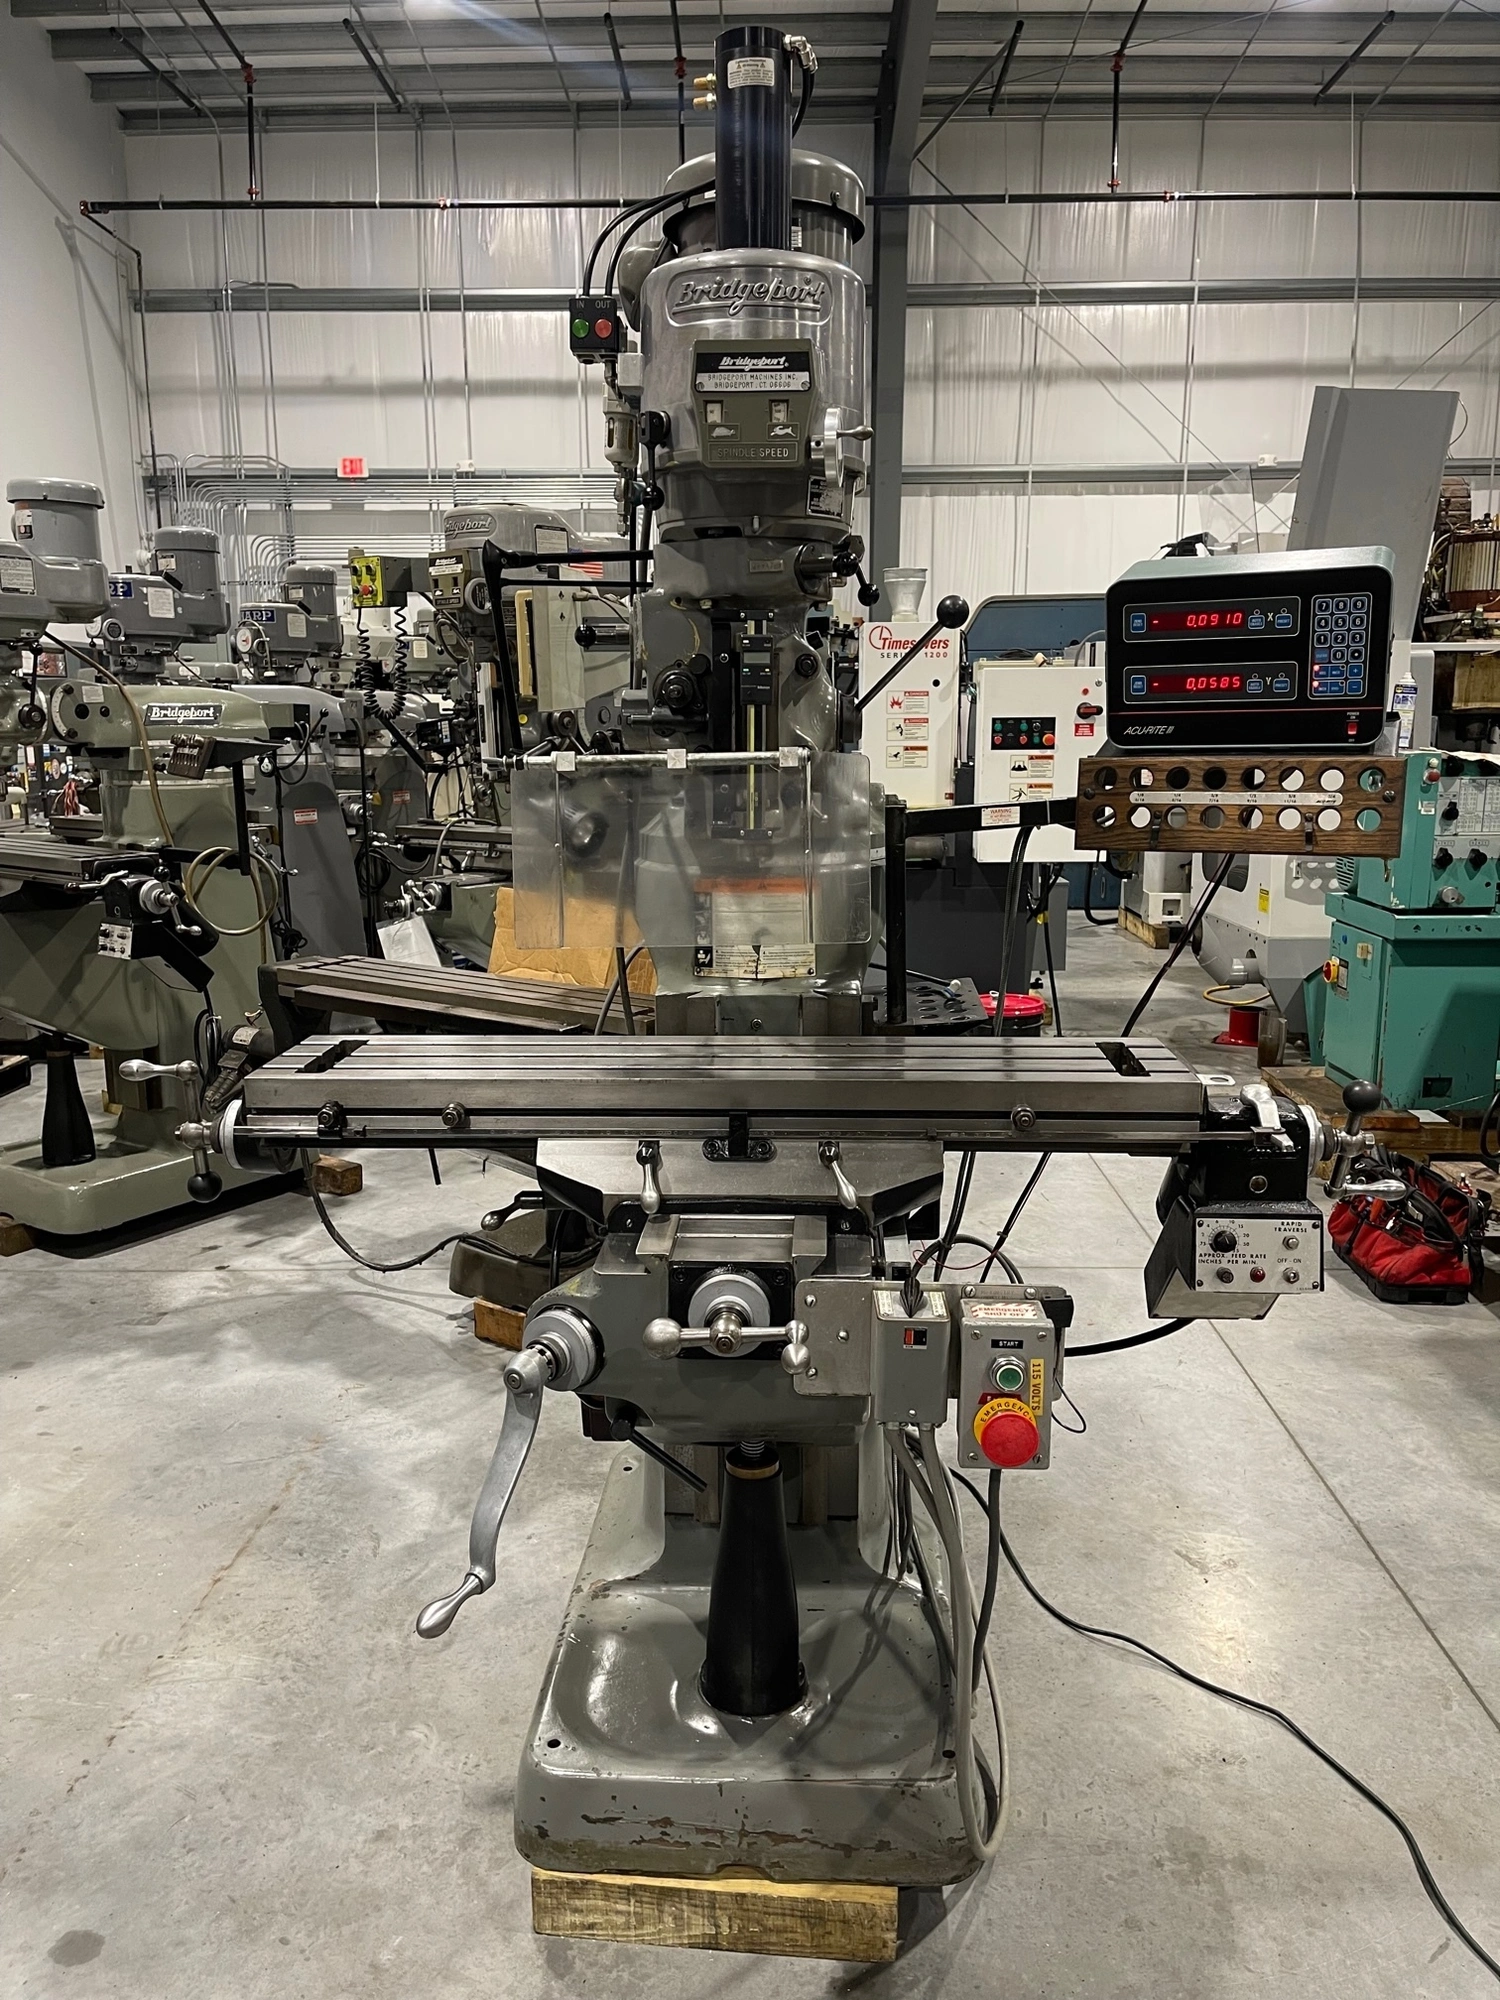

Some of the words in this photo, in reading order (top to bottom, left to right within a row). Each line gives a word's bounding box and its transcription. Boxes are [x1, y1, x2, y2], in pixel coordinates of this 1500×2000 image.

[676, 277, 825, 315] Bridgeport
[576, 301, 585, 309] IN
[595, 301, 610, 309] OUT
[718, 356, 786, 371] Bridgeport
[717, 447, 756, 457] SPINDLE
[759, 447, 789, 457] SPEED
[342, 458, 363, 475] EXIT
[1186, 613, 1242, 628] 0.0910
[1267, 612, 1274, 621] X
[1186, 676, 1240, 691] 0.0585
[1265, 677, 1271, 685] Y
[150, 706, 214, 724] Bridgeport
[1032, 1363, 1042, 1380] 115
[1031, 1383, 1042, 1411] VOLTS
